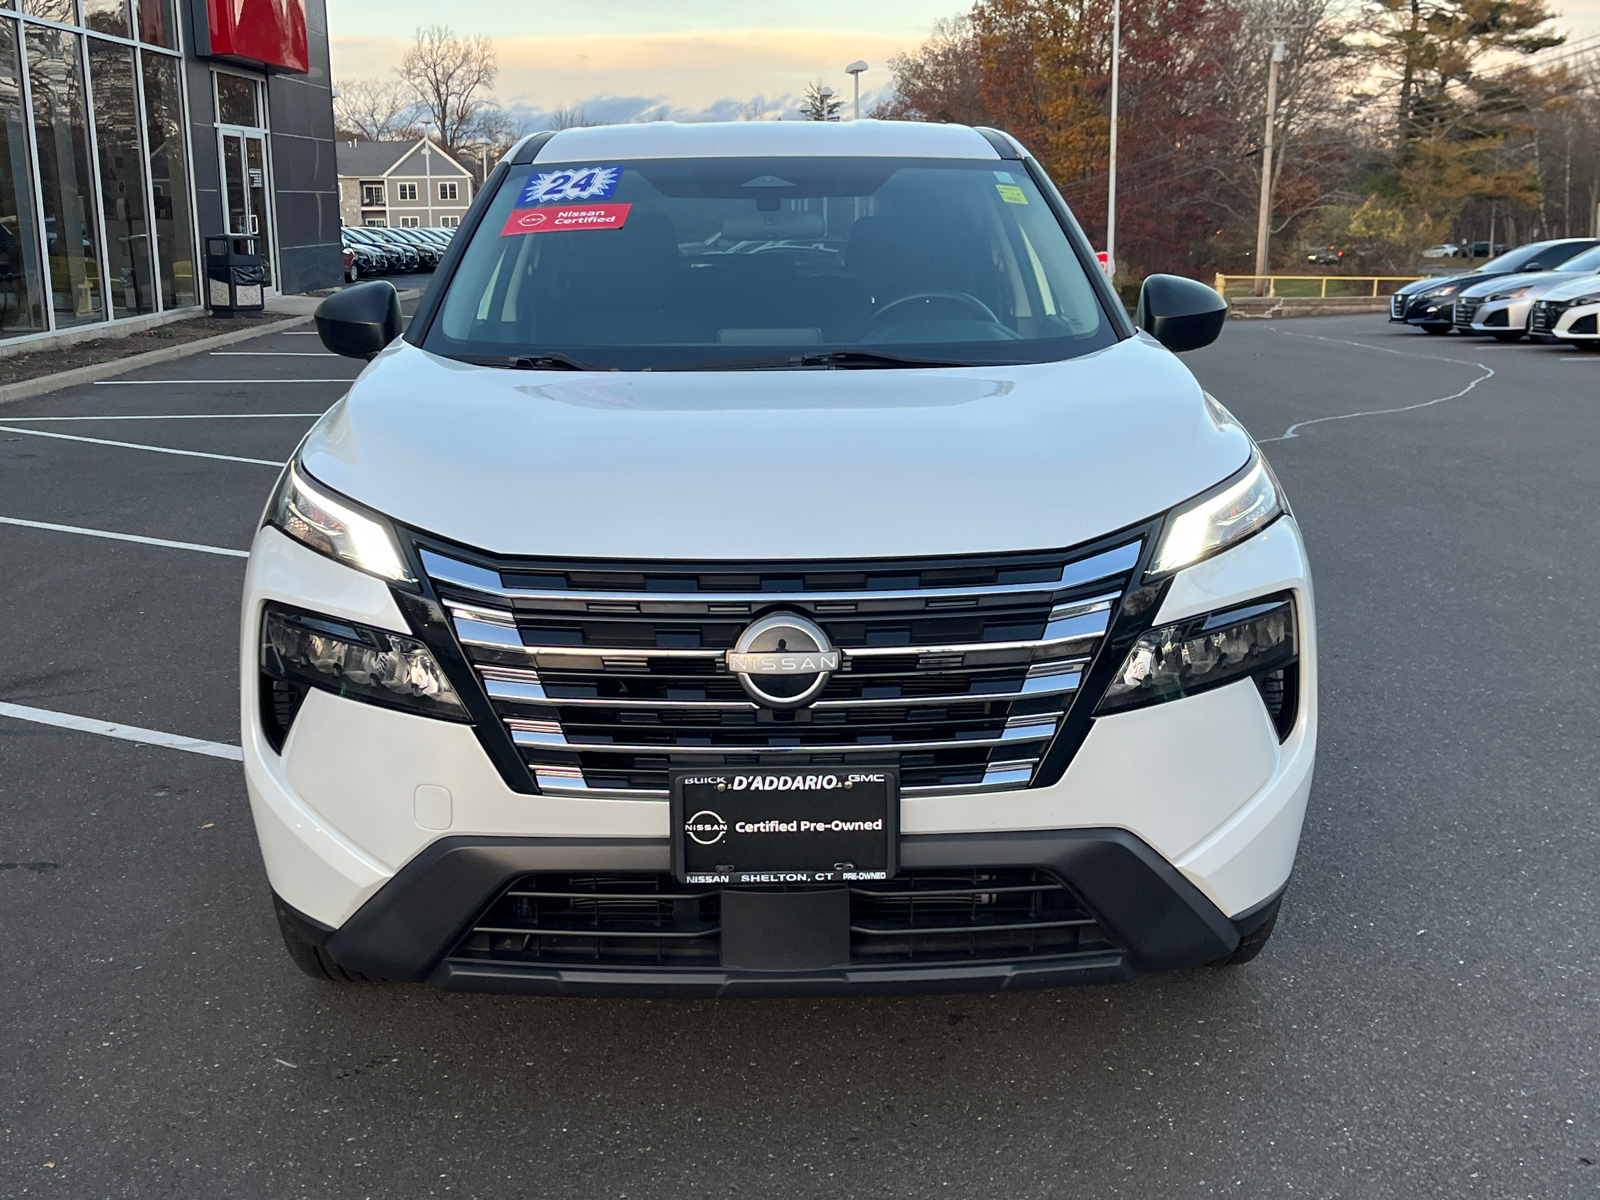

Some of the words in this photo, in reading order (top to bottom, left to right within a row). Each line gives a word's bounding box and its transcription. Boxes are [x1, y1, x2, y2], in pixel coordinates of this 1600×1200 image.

[541, 172, 598, 196] 24
[554, 216, 616, 225] Certified
[557, 210, 605, 218] Nissan
[731, 655, 837, 671] NISSAN
[684, 776, 727, 785] BUICK
[732, 775, 838, 791] D'ADDARIO
[848, 774, 885, 782] GMC
[735, 820, 797, 833] Certified
[800, 819, 883, 832] Pre-Owned
[686, 875, 730, 884] NISSAN
[740, 873, 811, 882] SHELTON,
[814, 872, 834, 881] CT
[842, 872, 887, 880] PRE-OWNED
